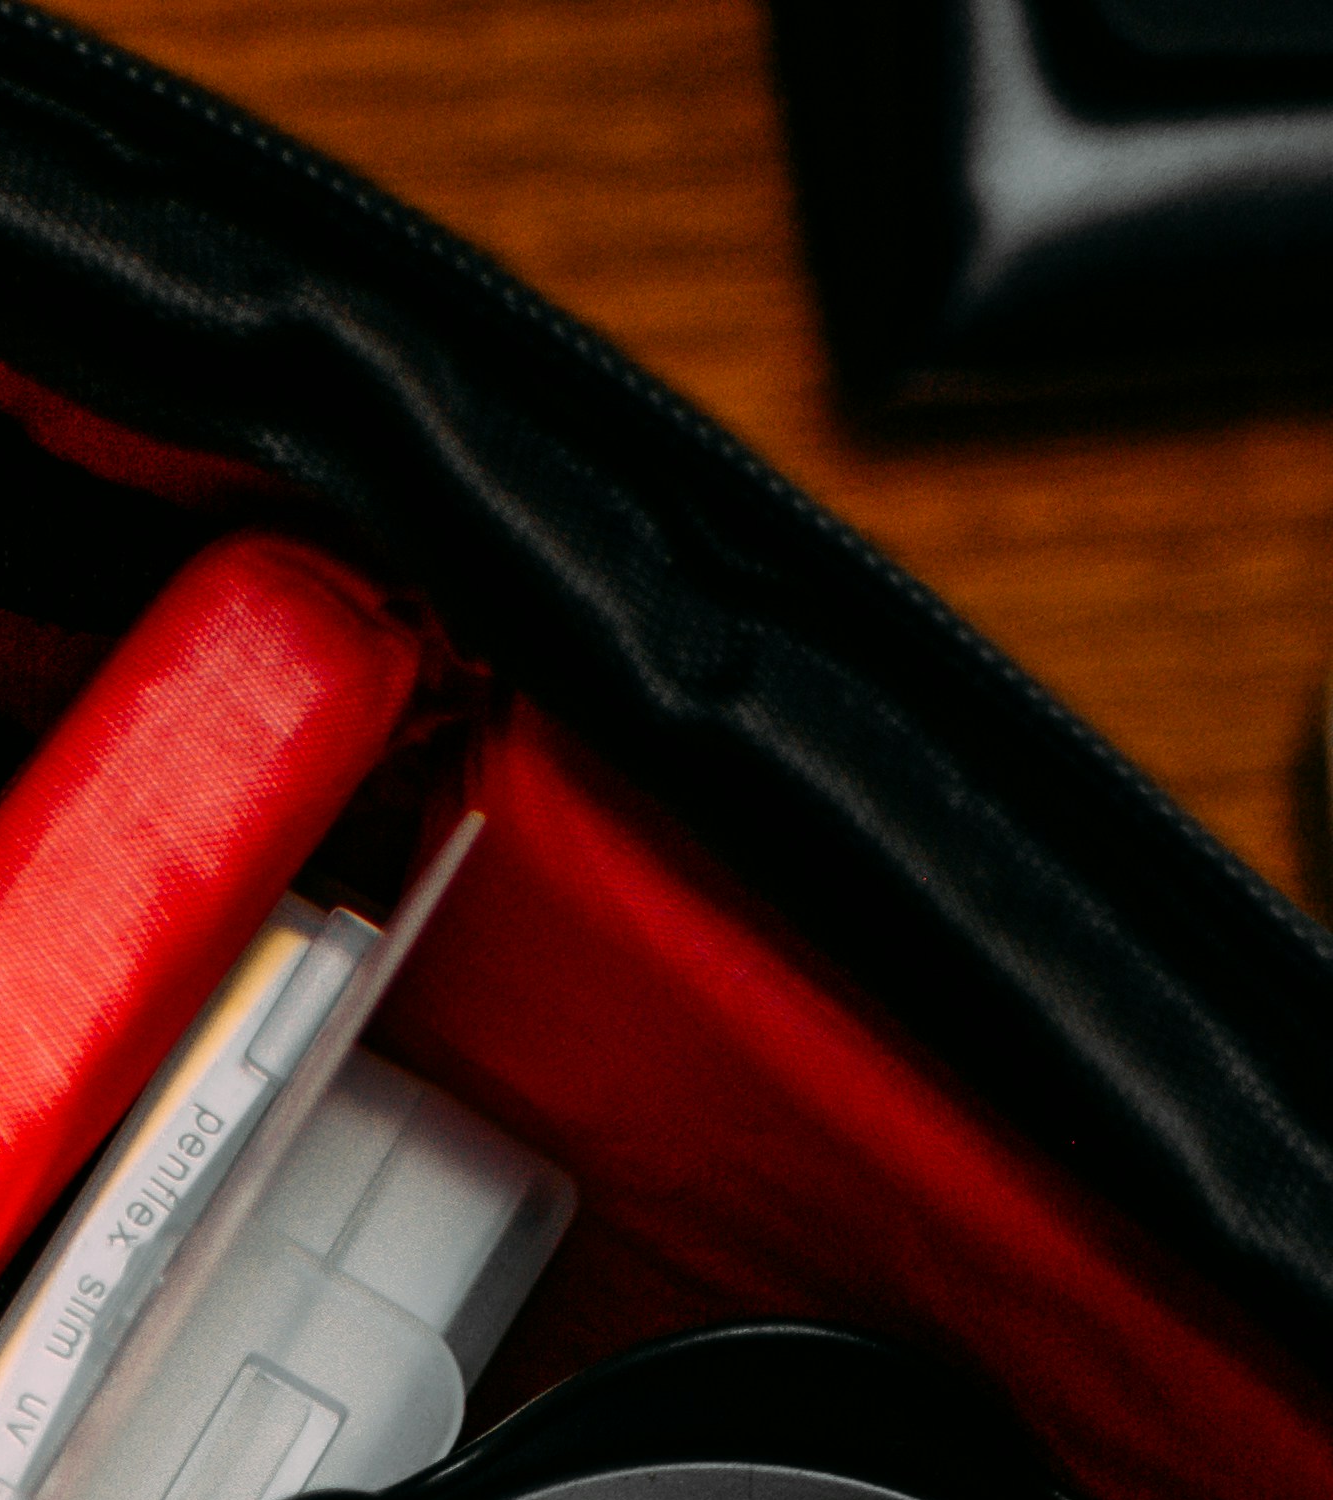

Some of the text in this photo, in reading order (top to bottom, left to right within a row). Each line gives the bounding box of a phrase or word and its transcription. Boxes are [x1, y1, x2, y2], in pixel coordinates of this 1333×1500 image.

[8, 1103, 225, 1448] penflex slim uv
